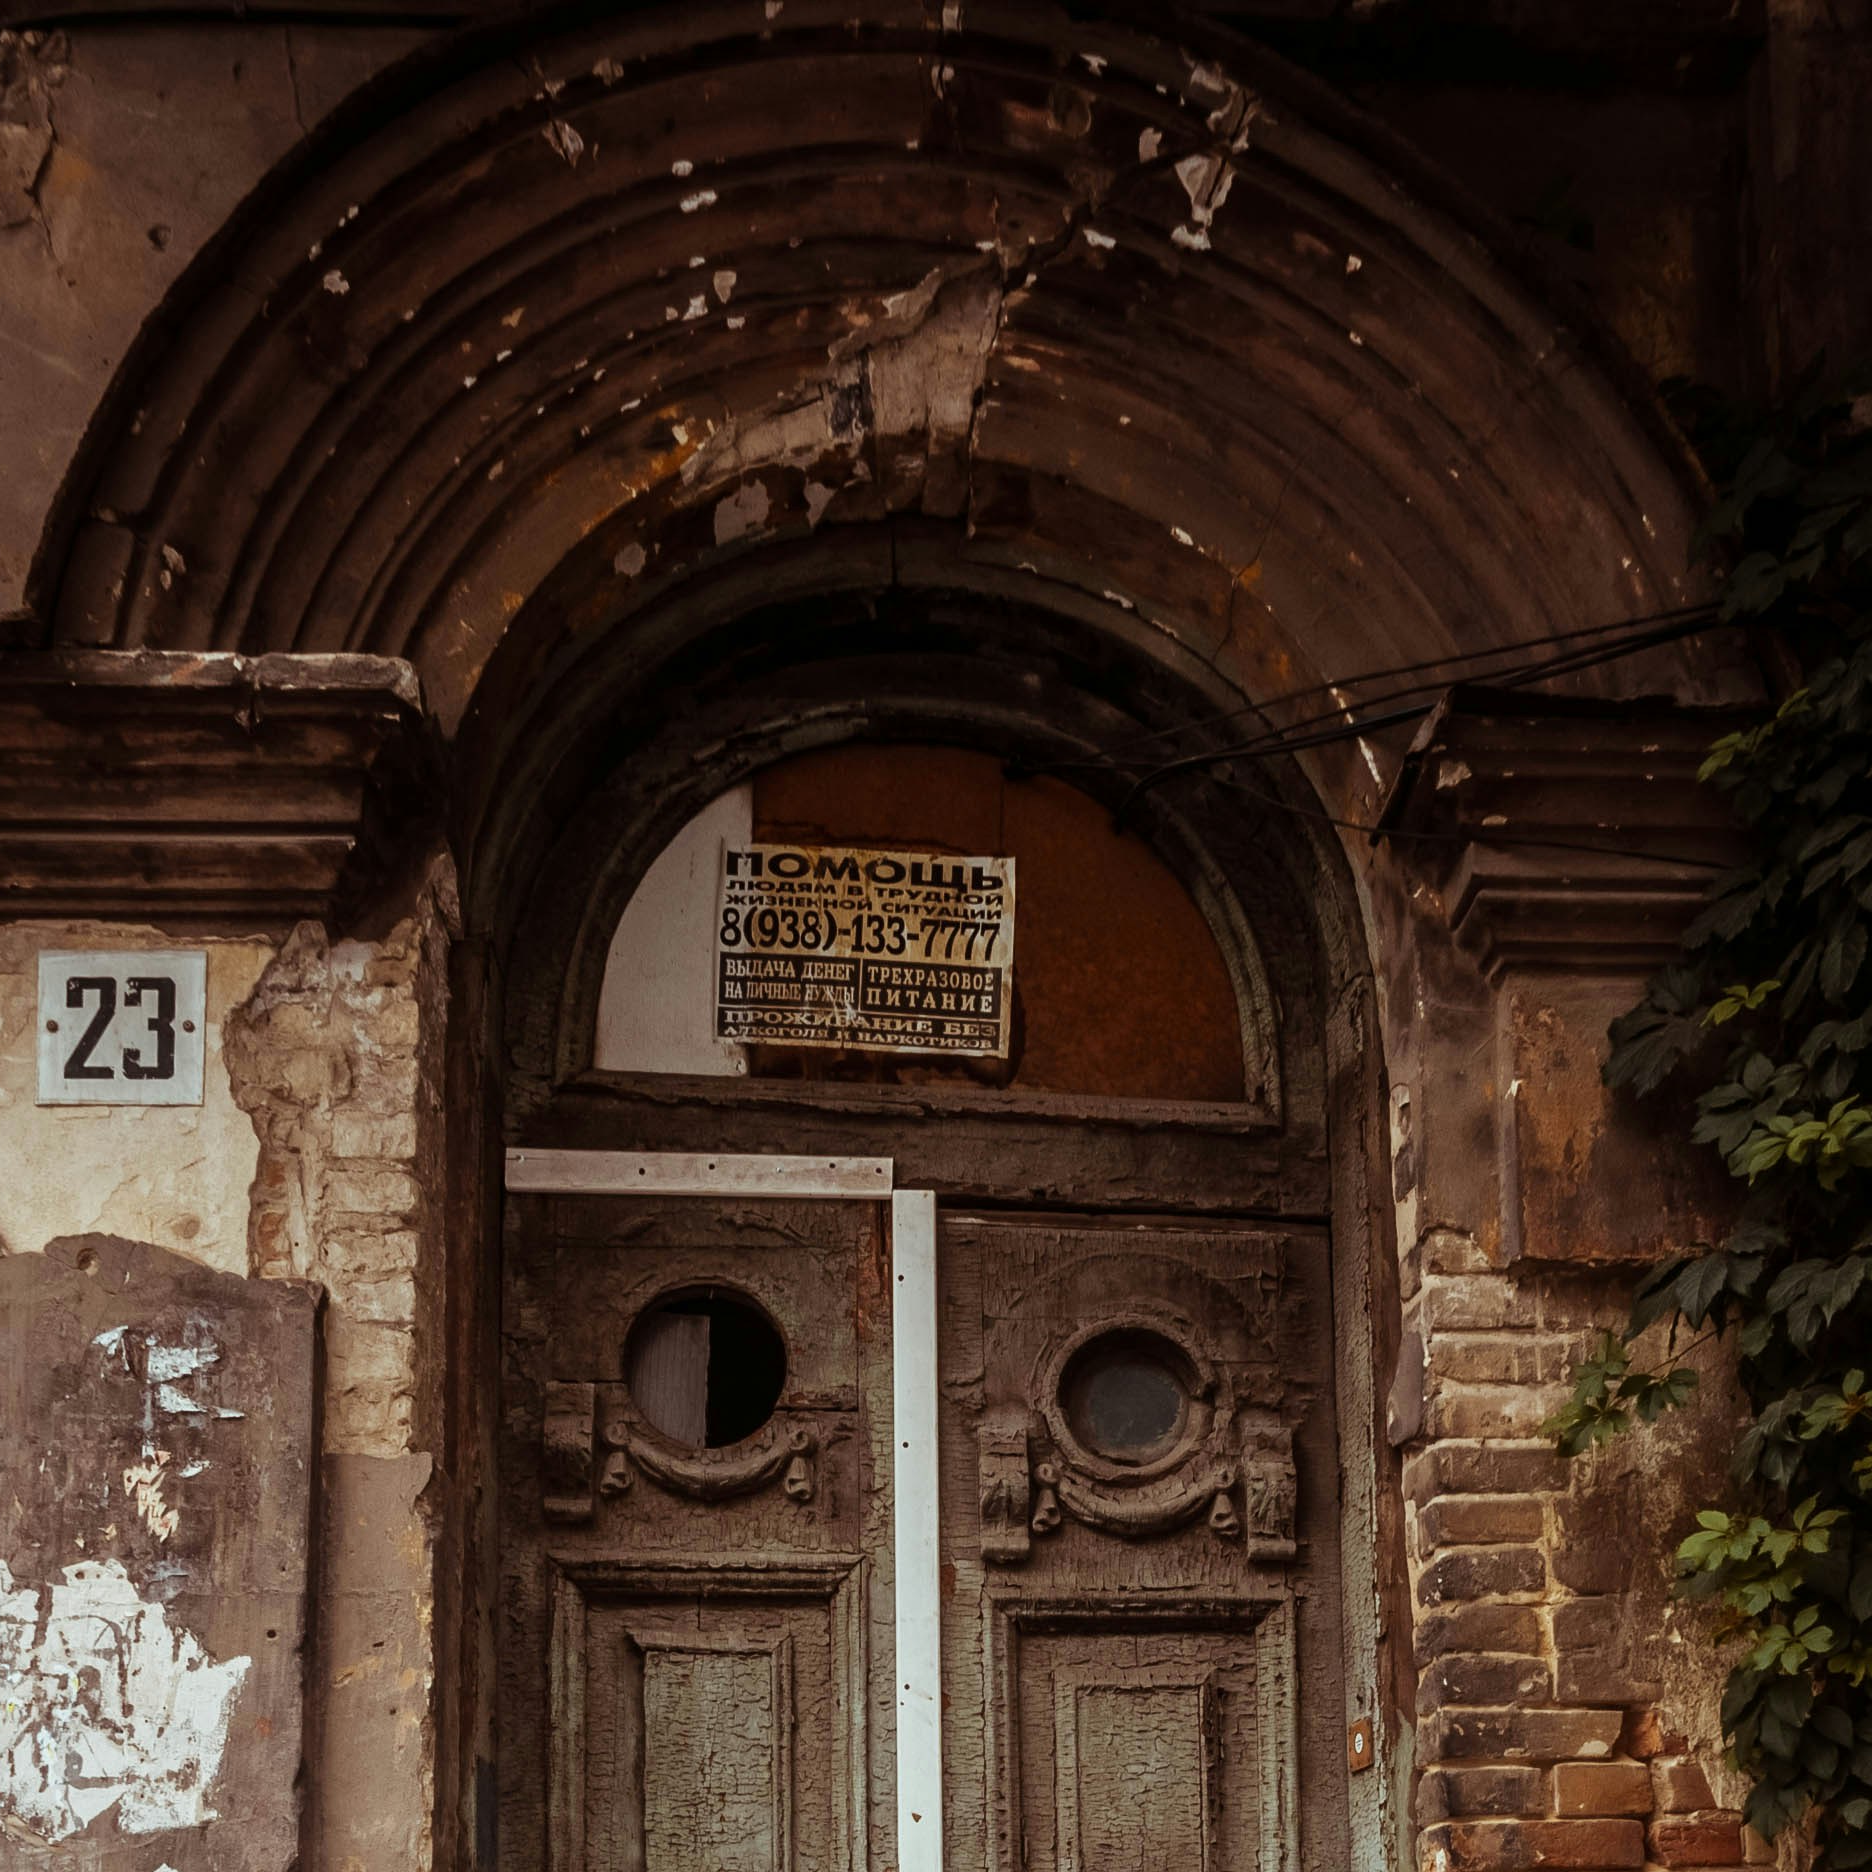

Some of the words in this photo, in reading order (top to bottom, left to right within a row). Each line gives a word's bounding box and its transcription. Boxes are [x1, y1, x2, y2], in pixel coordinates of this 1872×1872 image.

[726, 850, 1004, 894] ПОМОЩЬ
[726, 880, 837, 895] ЛЮДЯМ
[847, 884, 865, 897] В
[874, 886, 1004, 907] ТРУДНОЙ
[725, 894, 873, 912] ЖИЗНЕННОЙ
[880, 901, 1002, 921] СИТУАЦИИ
[719, 905, 1001, 962] 8(938)-133-7777
[725, 958, 797, 979] ВЫДАЧА
[800, 961, 856, 982] ДЕНЕГ
[867, 965, 995, 992] ТРЕХРАЗОВОЕ
[724, 981, 743, 999] НА
[746, 981, 802, 1001] ЛИЧНЫЕ
[804, 983, 856, 1005] НУЖДЫ
[866, 986, 993, 1014] ПИТАНИЕ
[64, 977, 176, 1079] 23
[723, 1010, 933, 1034] ПРОЖИВАНИЕ
[943, 1021, 997, 1037] БЕЗ
[723, 1025, 829, 1038] АЛКОГОЛЯ
[834, 1030, 849, 1042] И
[857, 1031, 993, 1049] НАРКОТИКОВ
